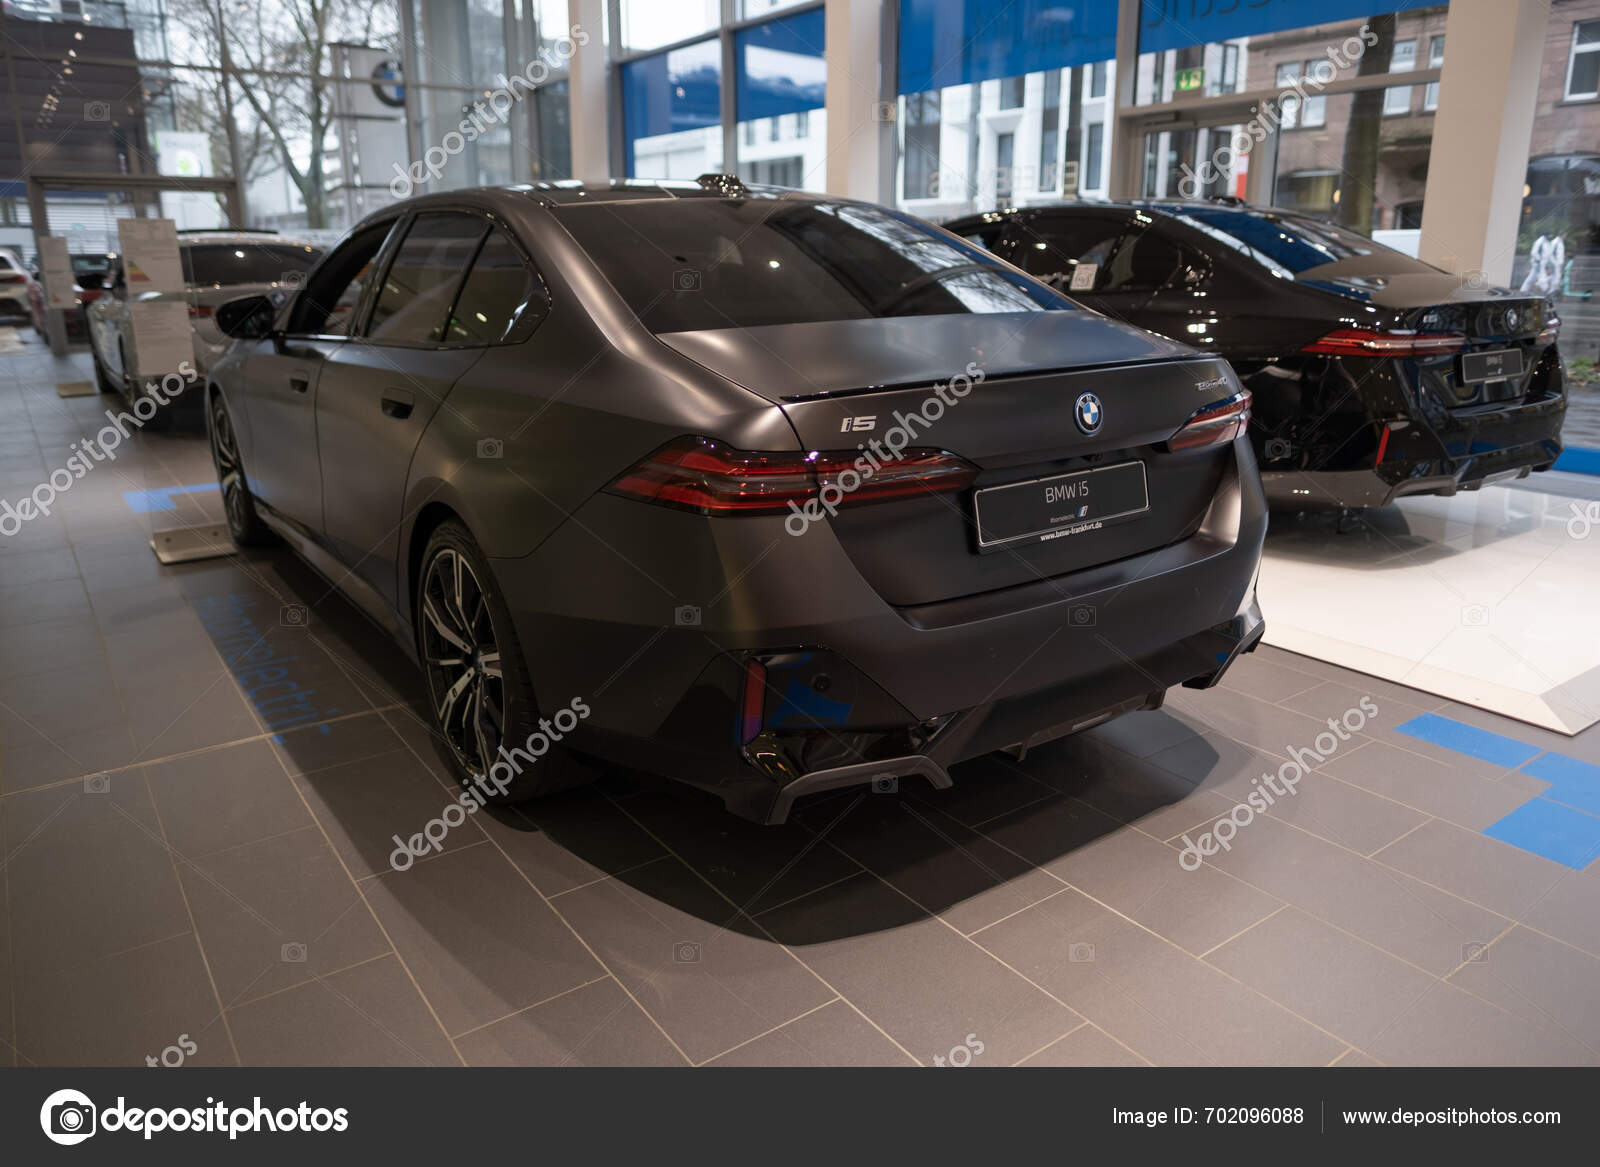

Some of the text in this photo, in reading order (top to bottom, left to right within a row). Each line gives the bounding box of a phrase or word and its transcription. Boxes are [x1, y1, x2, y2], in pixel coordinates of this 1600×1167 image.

[840, 415, 877, 433] i5
[1045, 480, 1089, 504] BMW i5
[1040, 521, 1103, 542] www.bmw-frankfurt.de
